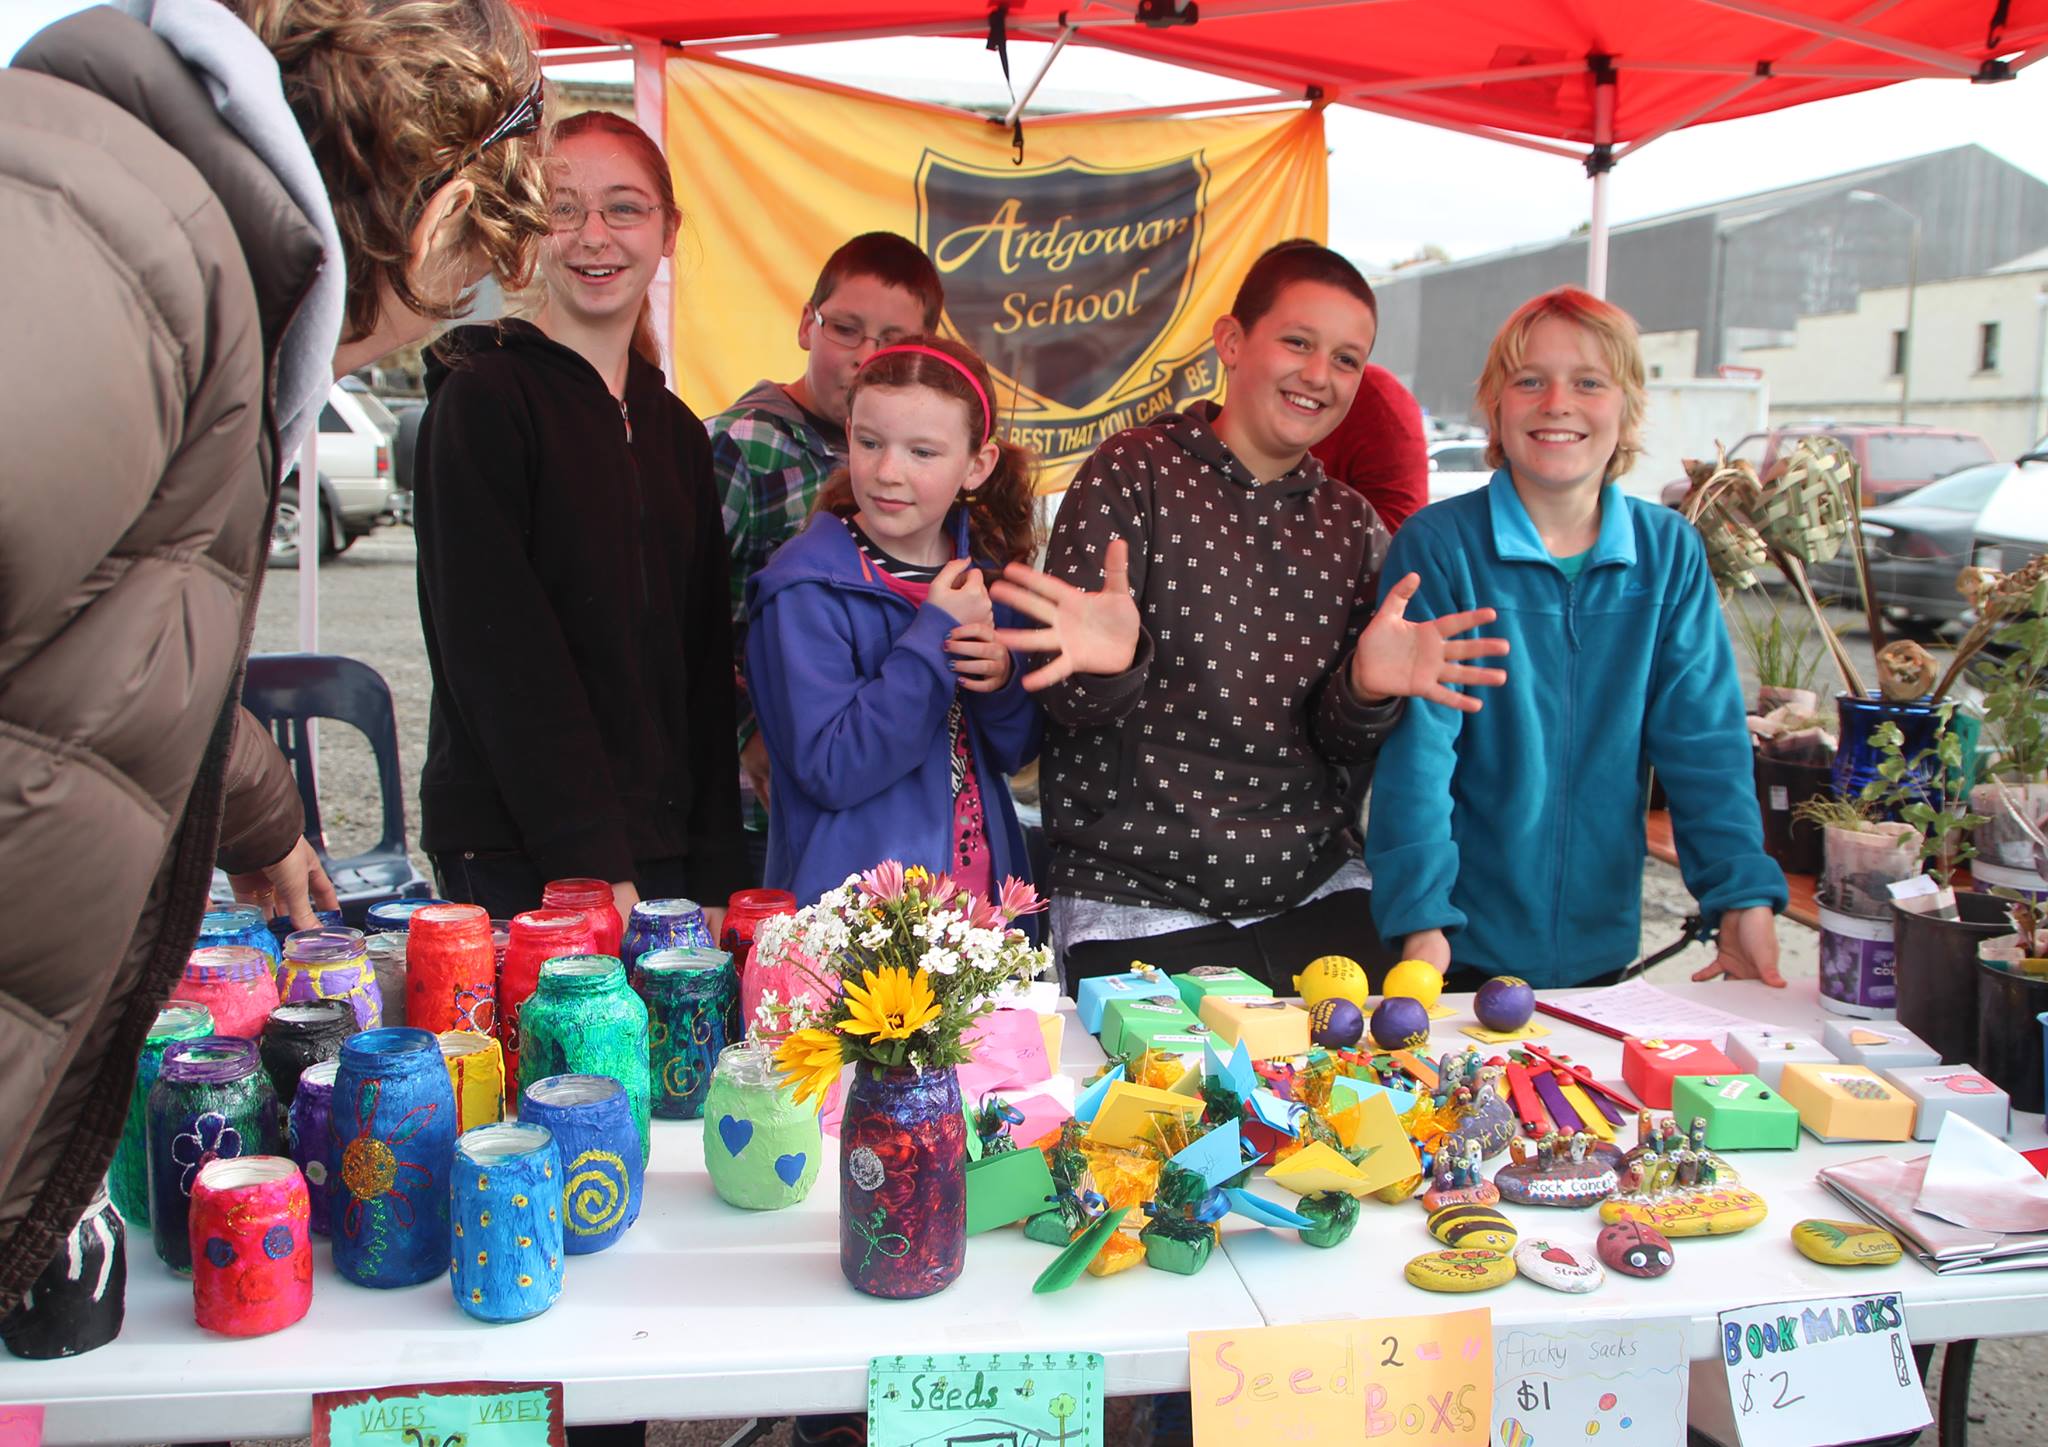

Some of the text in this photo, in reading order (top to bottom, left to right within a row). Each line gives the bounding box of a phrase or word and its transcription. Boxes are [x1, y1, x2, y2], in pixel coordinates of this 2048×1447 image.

[935, 199, 1190, 274] Ardgowan
[993, 268, 1150, 334] School
[1009, 426, 1058, 454] BEST
[1057, 422, 1098, 452] THAT
[1099, 412, 1133, 440] YOU
[1136, 387, 1173, 422] CAN
[1184, 359, 1213, 392] BE
[1216, 1334, 1354, 1406] Seed
[1380, 1336, 1404, 1367] 2
[1504, 1338, 1567, 1369] Hacky
[911, 1371, 998, 1410] Seeds
[1517, 1380, 1551, 1412] $1
[361, 1399, 542, 1432] VASES VASES
